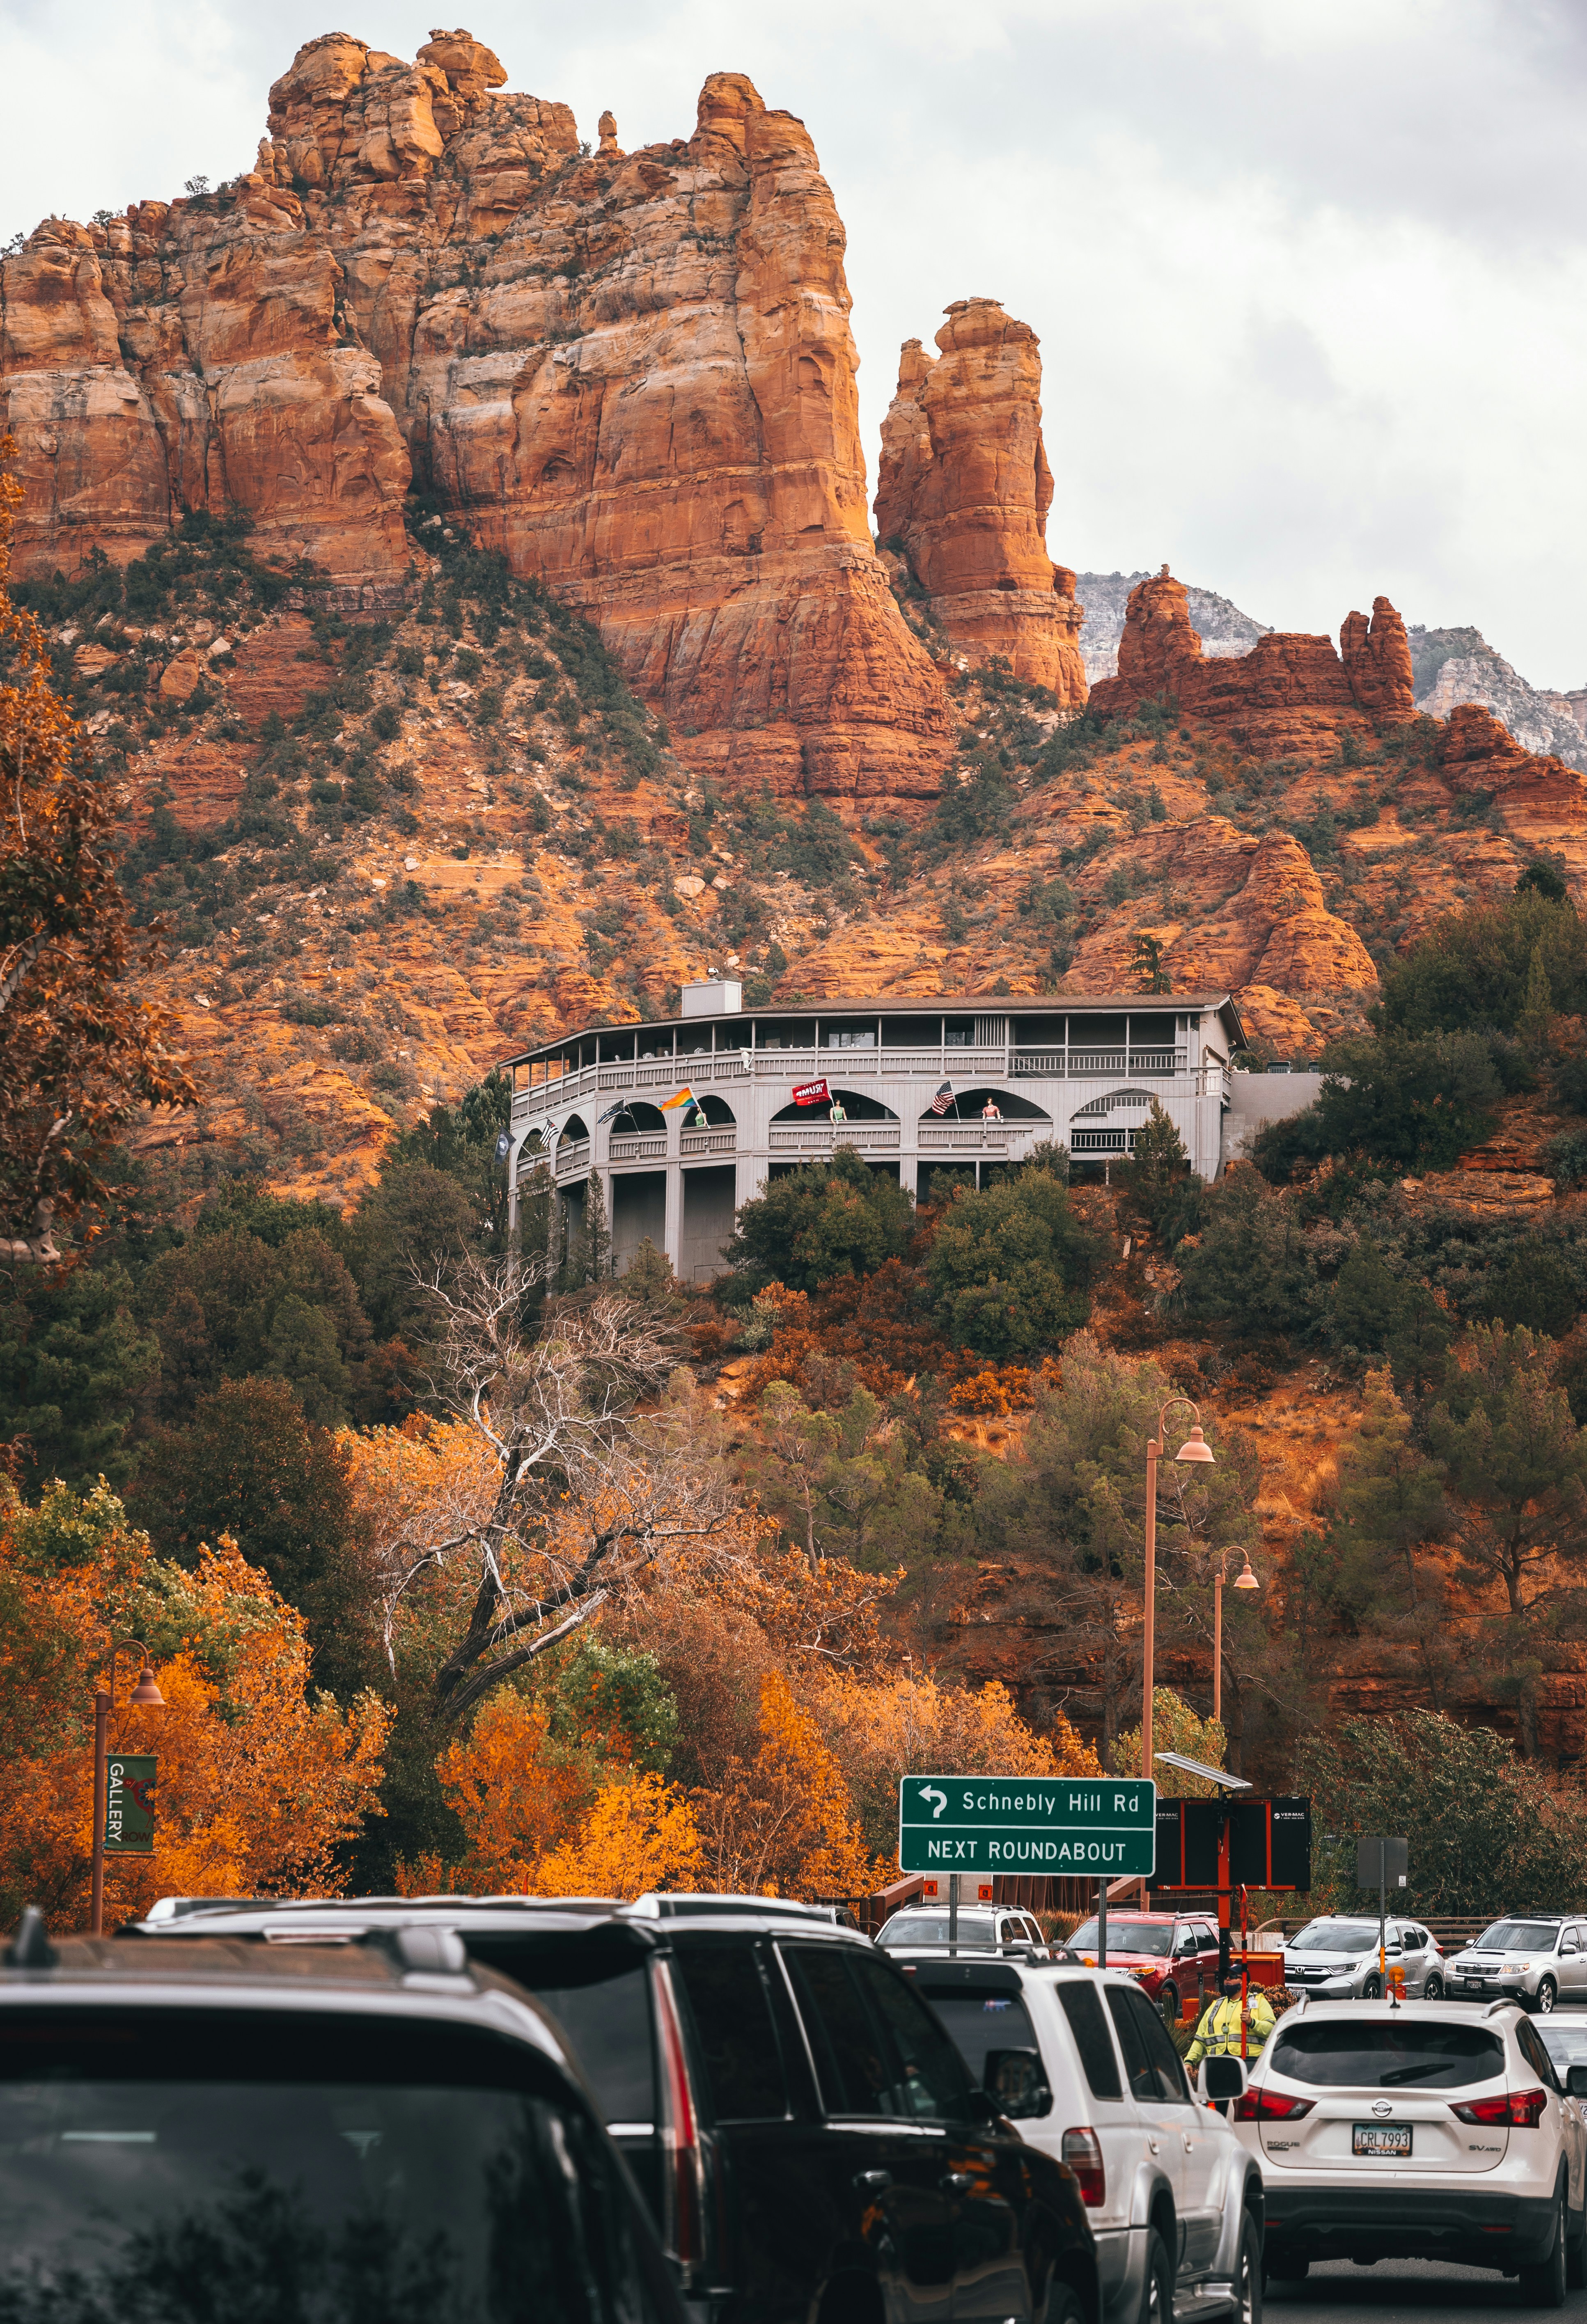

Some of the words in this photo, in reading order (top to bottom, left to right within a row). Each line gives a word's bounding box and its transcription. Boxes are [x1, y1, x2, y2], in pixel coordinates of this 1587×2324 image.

[108, 1763, 124, 1842] GALLERY
[963, 1792, 1055, 1815] Schnebly
[1069, 1794, 1100, 1811] Hill
[1115, 1794, 1138, 1812] Rd
[122, 1832, 151, 1842] ROW
[929, 1840, 977, 1858] NEXT
[989, 1841, 1126, 1861] ROUNDABOUT
[1361, 2132, 1408, 2148] CRL7993
